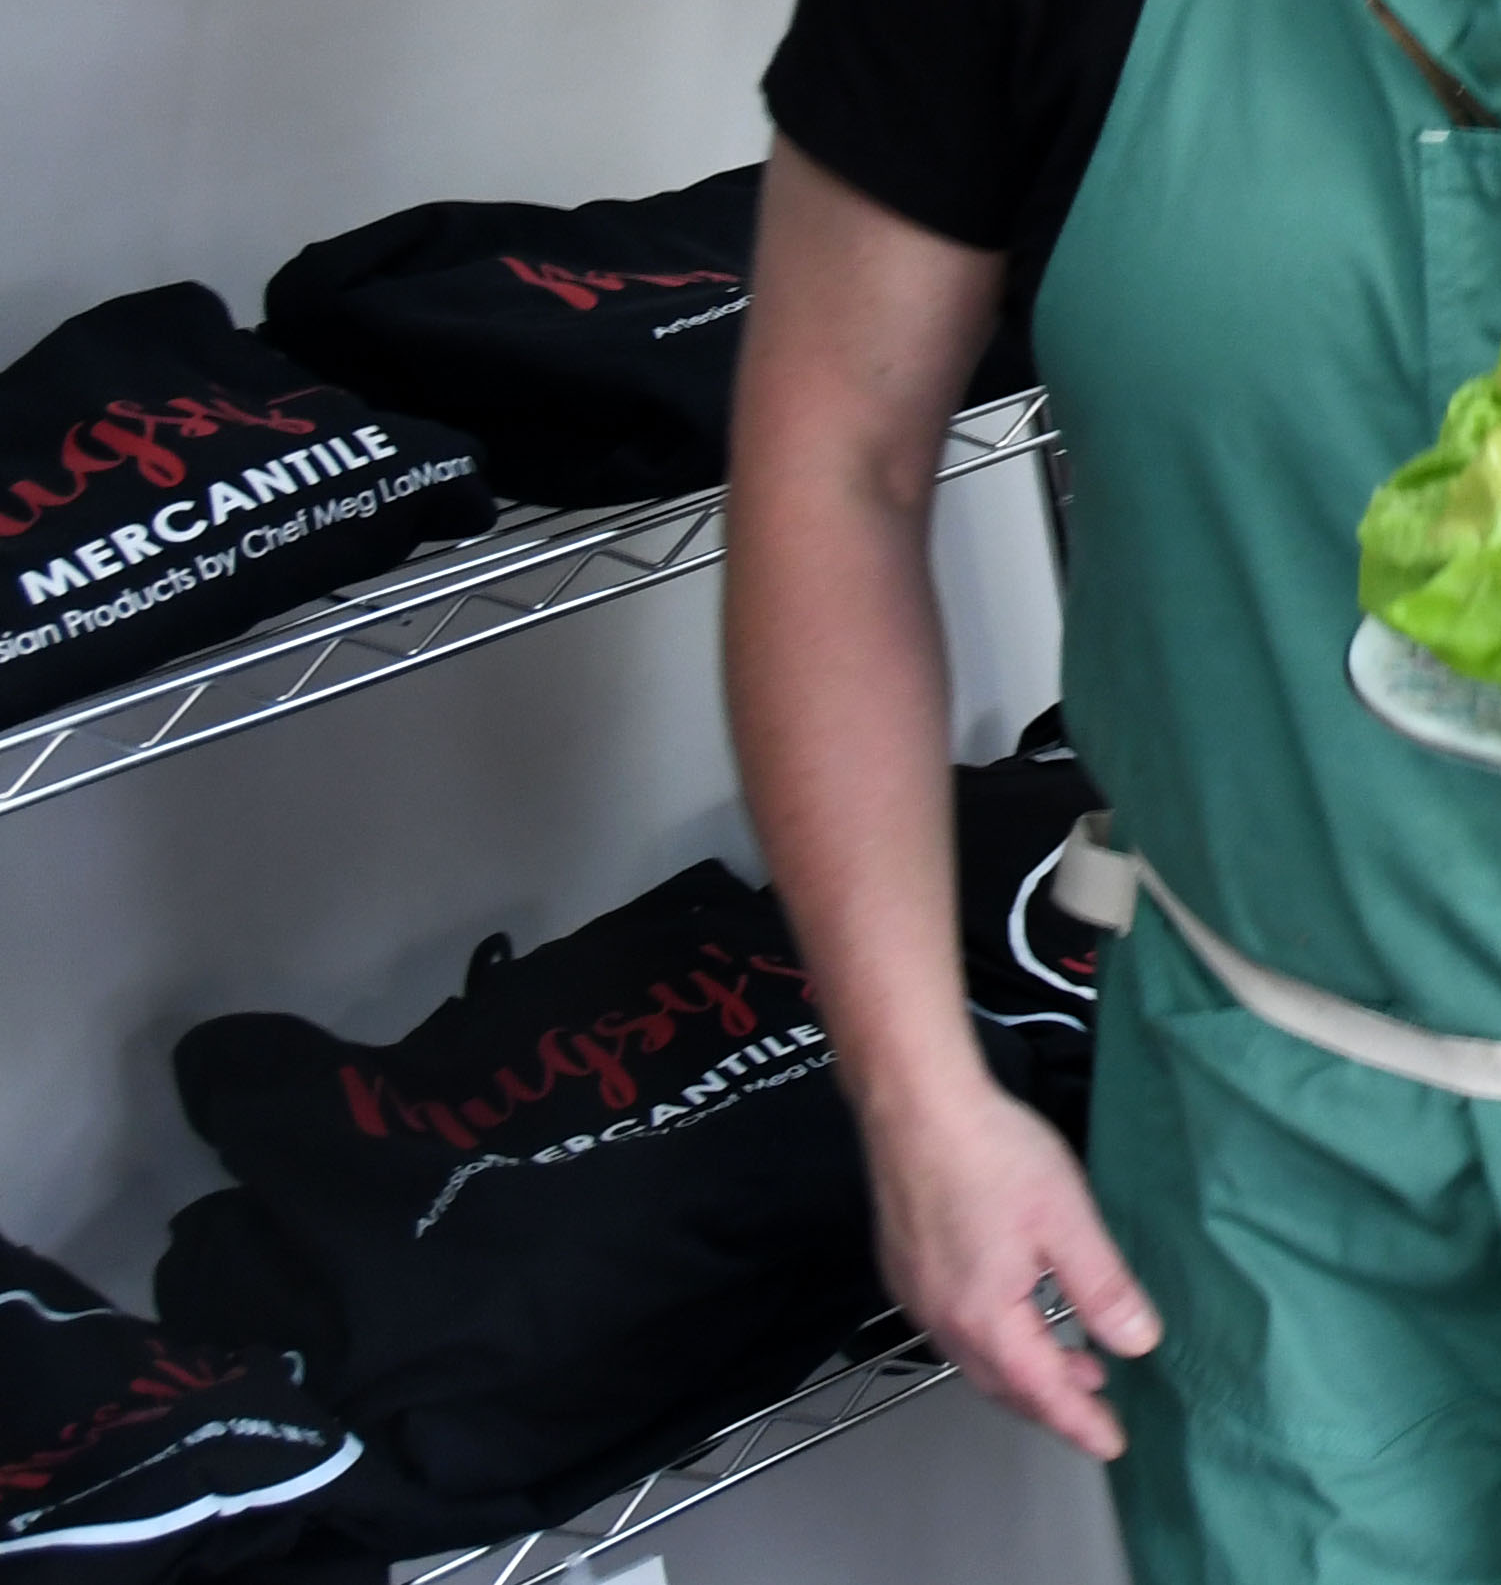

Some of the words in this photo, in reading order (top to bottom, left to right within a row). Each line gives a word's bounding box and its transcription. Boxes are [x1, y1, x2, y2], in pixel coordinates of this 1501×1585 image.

[0, 619, 62, 664] sian
[62, 568, 197, 640] Products
[199, 544, 238, 582] by
[240, 510, 308, 559] Chef
[312, 491, 378, 531] Meg
[18, 424, 399, 606] MERCANTILE
[520, 1022, 828, 1165] ERCANTILE
